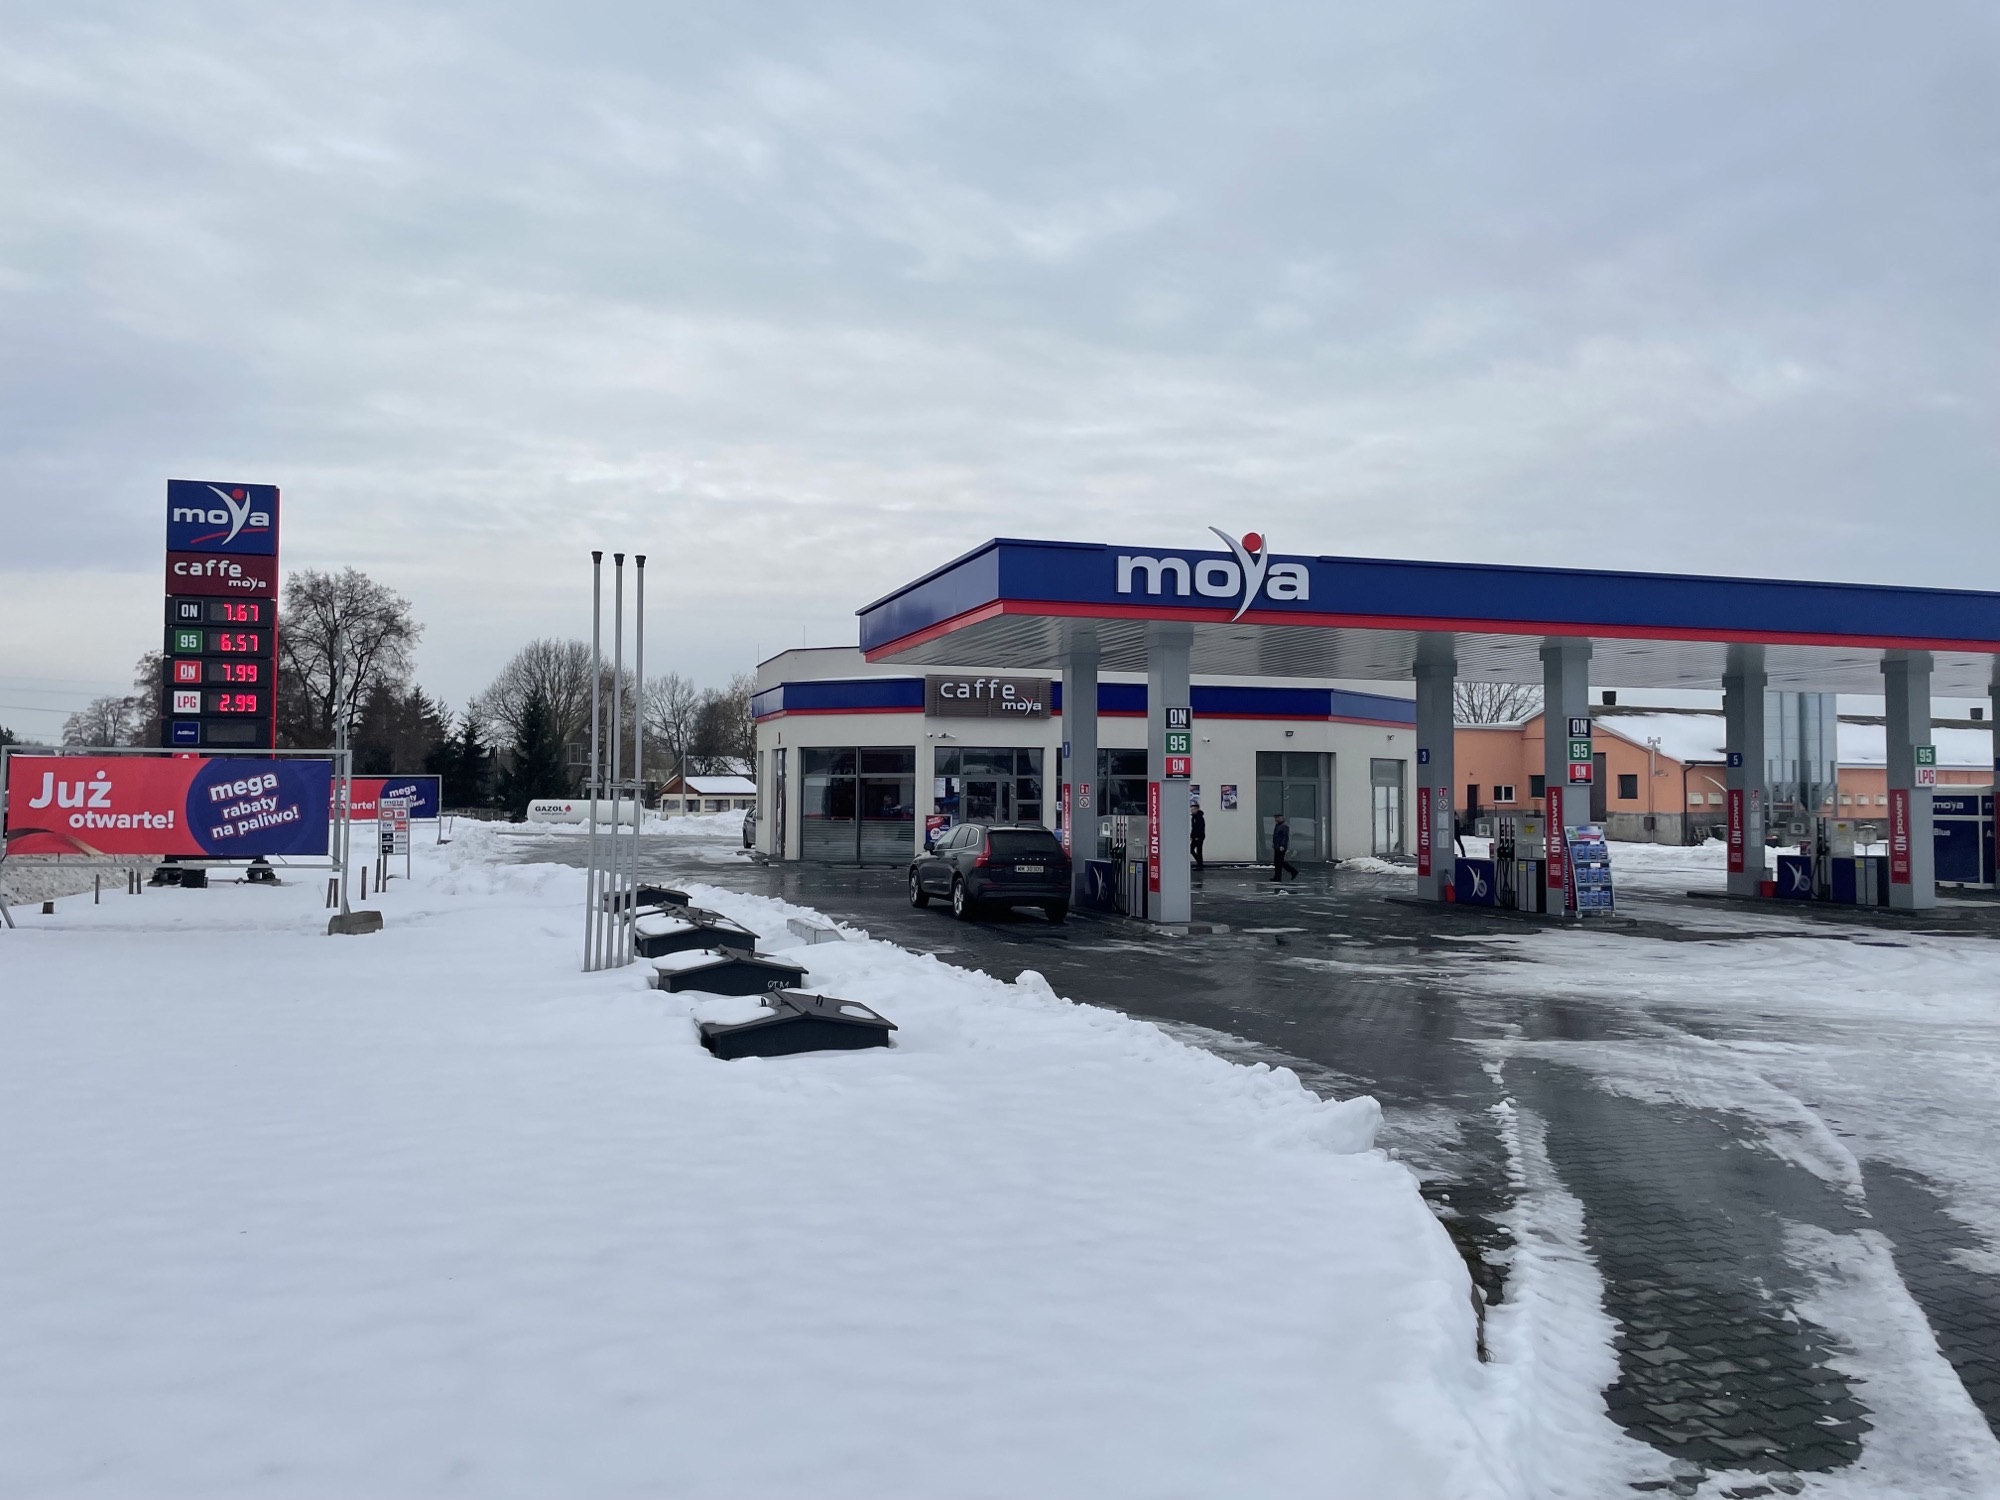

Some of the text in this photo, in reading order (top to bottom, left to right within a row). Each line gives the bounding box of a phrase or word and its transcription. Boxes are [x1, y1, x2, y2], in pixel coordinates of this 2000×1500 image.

[173, 485, 270, 545] moya
[174, 559, 242, 577] caffe
[1116, 526, 1310, 622] moya
[228, 576, 266, 591] moya
[181, 603, 259, 621] ON 7.67
[180, 633, 258, 651] 95 6.57
[180, 664, 257, 682] ON 7.99
[940, 678, 1016, 699] caffe
[177, 693, 257, 712] LPG 2.99
[1002, 696, 1042, 716] moya
[1170, 709, 1187, 724] ON
[1572, 719, 1588, 734] ON
[1170, 735, 1187, 751] 95
[1573, 743, 1588, 758] 95
[1172, 759, 1185, 771] ON
[1422, 751, 1426, 762] 3
[1733, 754, 1738, 765] 5
[1919, 749, 1932, 763] 95
[1575, 765, 1587, 776] ON
[1918, 769, 1935, 784] LPG
[29, 770, 112, 808] Już
[210, 774, 278, 801] mega
[389, 785, 416, 798] mega
[223, 797, 277, 819] rabaty
[69, 810, 174, 829] otwarte!
[212, 806, 299, 838] na paliwo!
[1895, 794, 1906, 851] ON power
[1151, 835, 1159, 854] ON
[1421, 831, 1429, 845] ON
[1551, 836, 1561, 852] ON
[1731, 830, 1741, 844] ON
